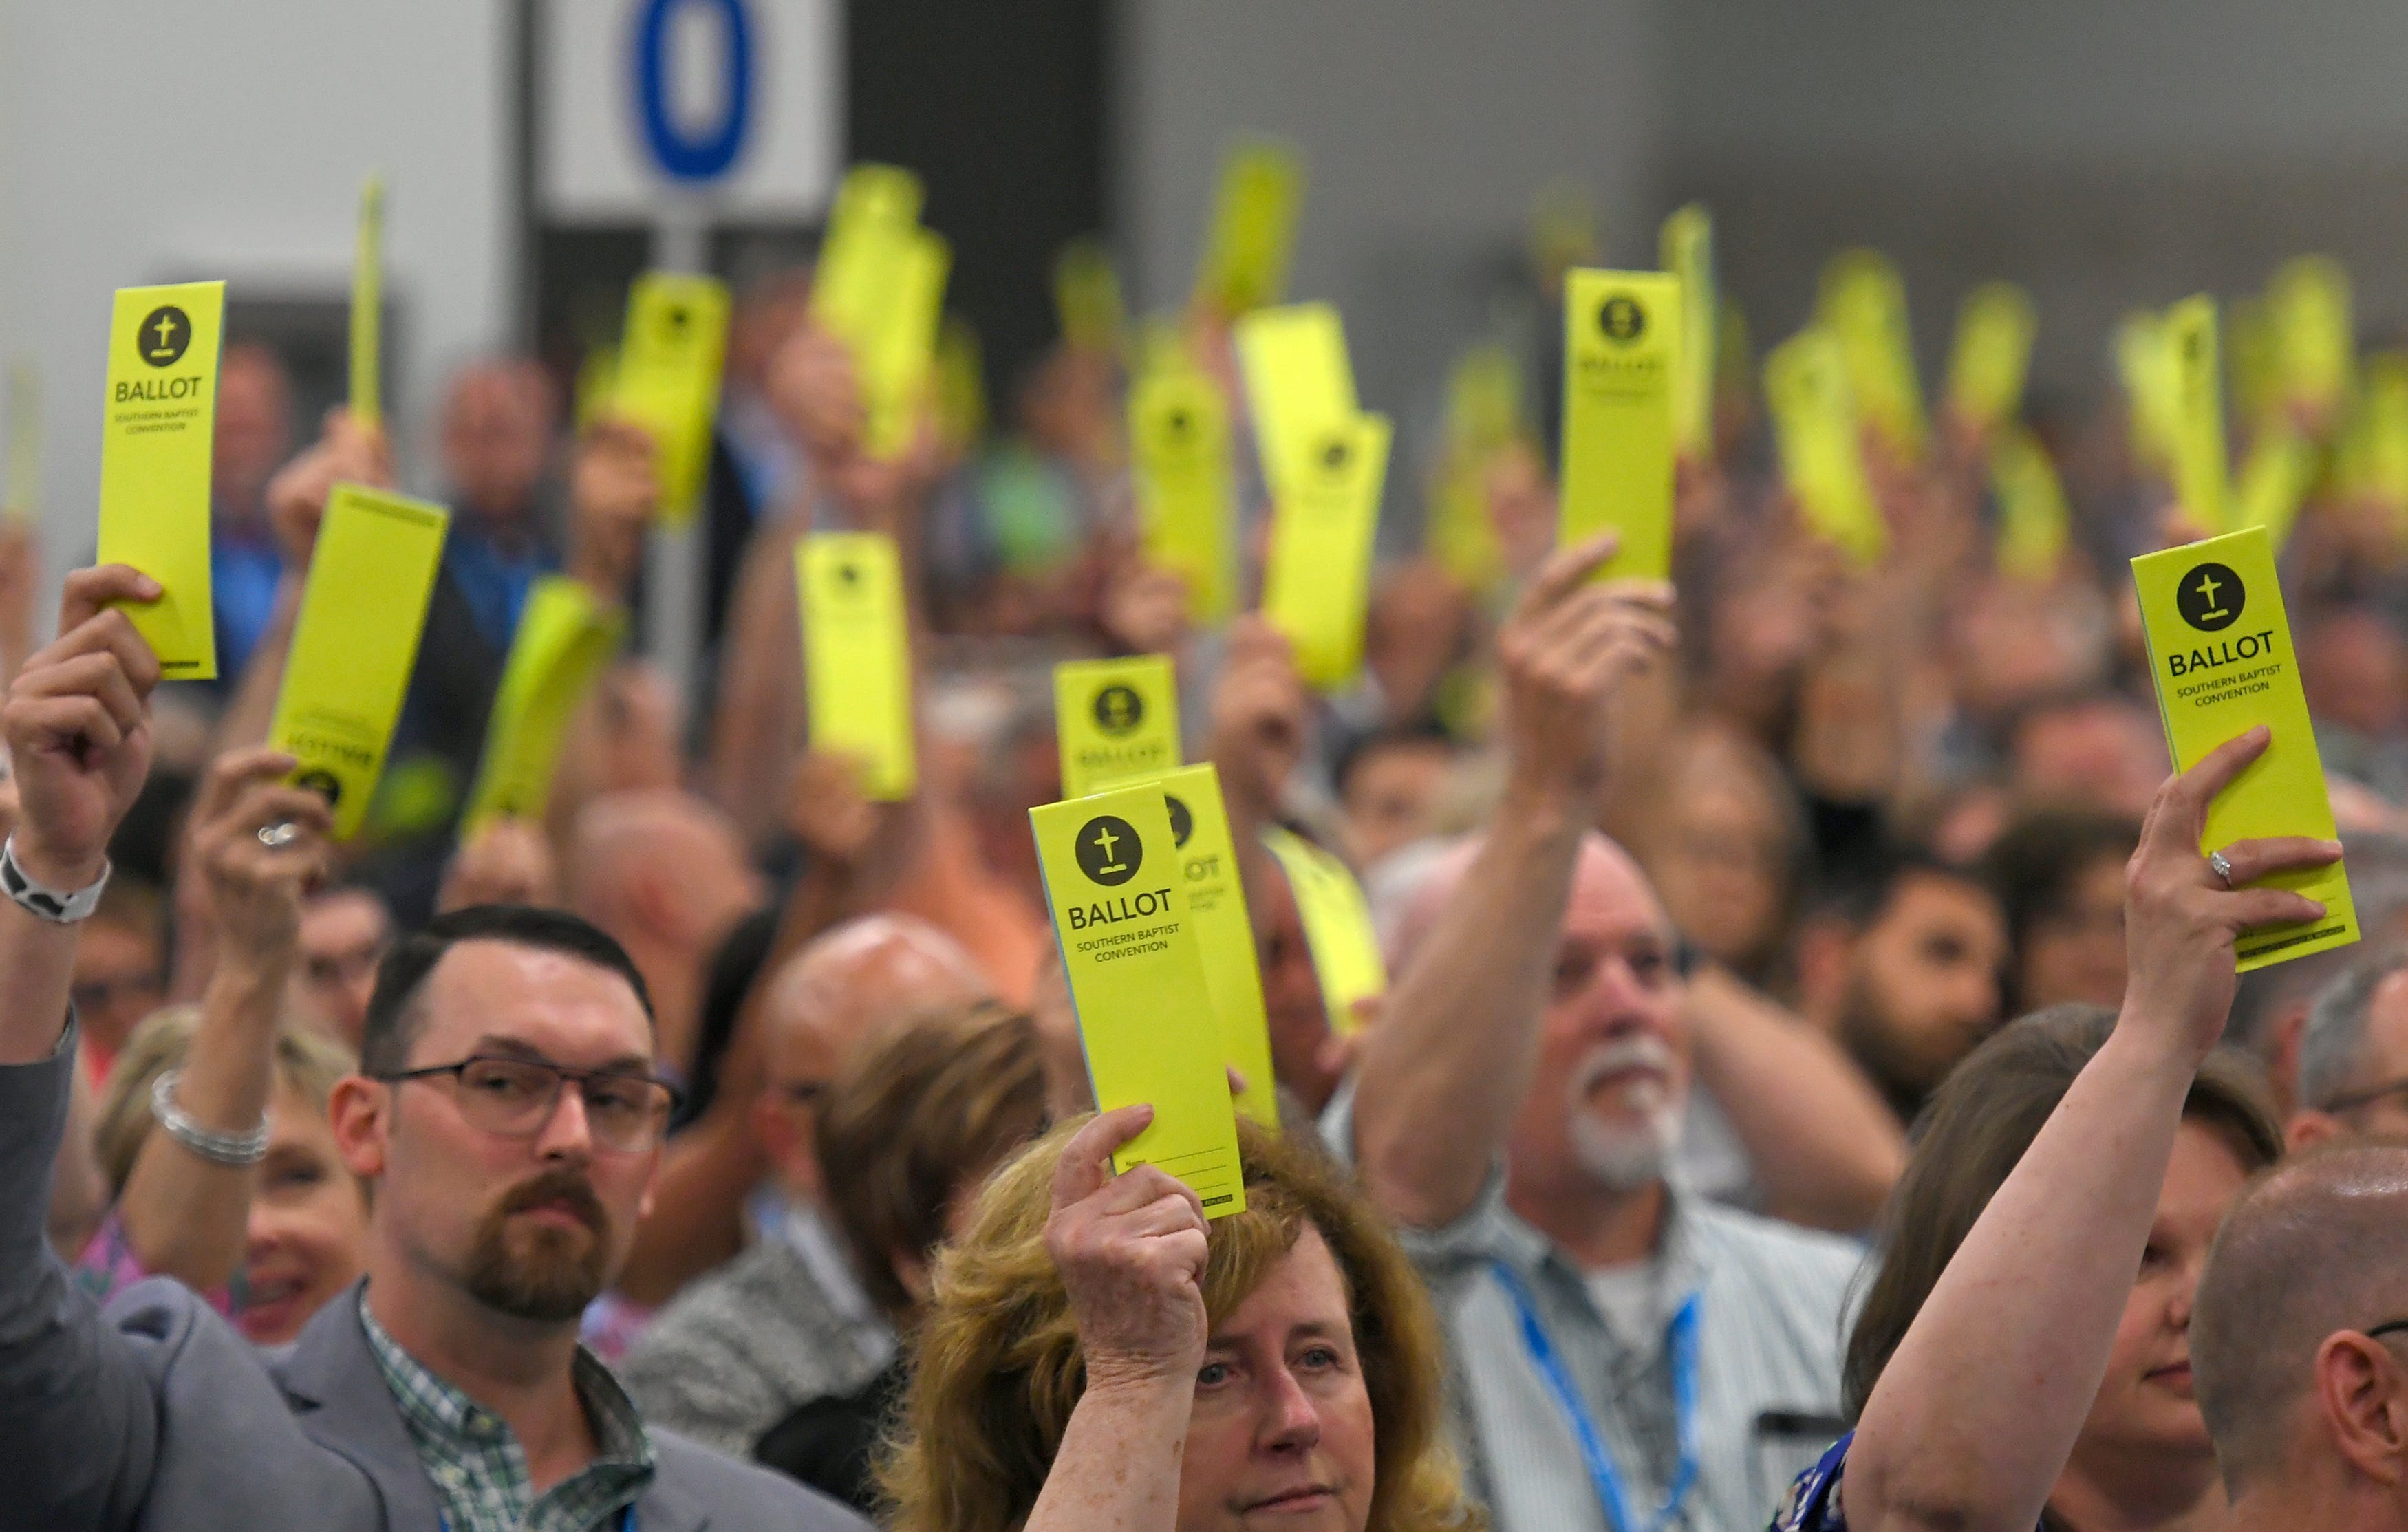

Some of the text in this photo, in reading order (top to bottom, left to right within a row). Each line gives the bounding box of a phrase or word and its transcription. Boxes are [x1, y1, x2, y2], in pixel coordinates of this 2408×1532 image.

[115, 376, 202, 402] BALLOT
[2169, 631, 2273, 676] BALLOT
[2177, 664, 2282, 698] SOUTHERN BAPTIST
[2195, 682, 2270, 707] CONVENTION
[1068, 888, 1172, 930] BALLOT
[1077, 923, 1180, 953] SOUTHERN BAPTIST
[1095, 940, 1169, 962] CONVENTION
